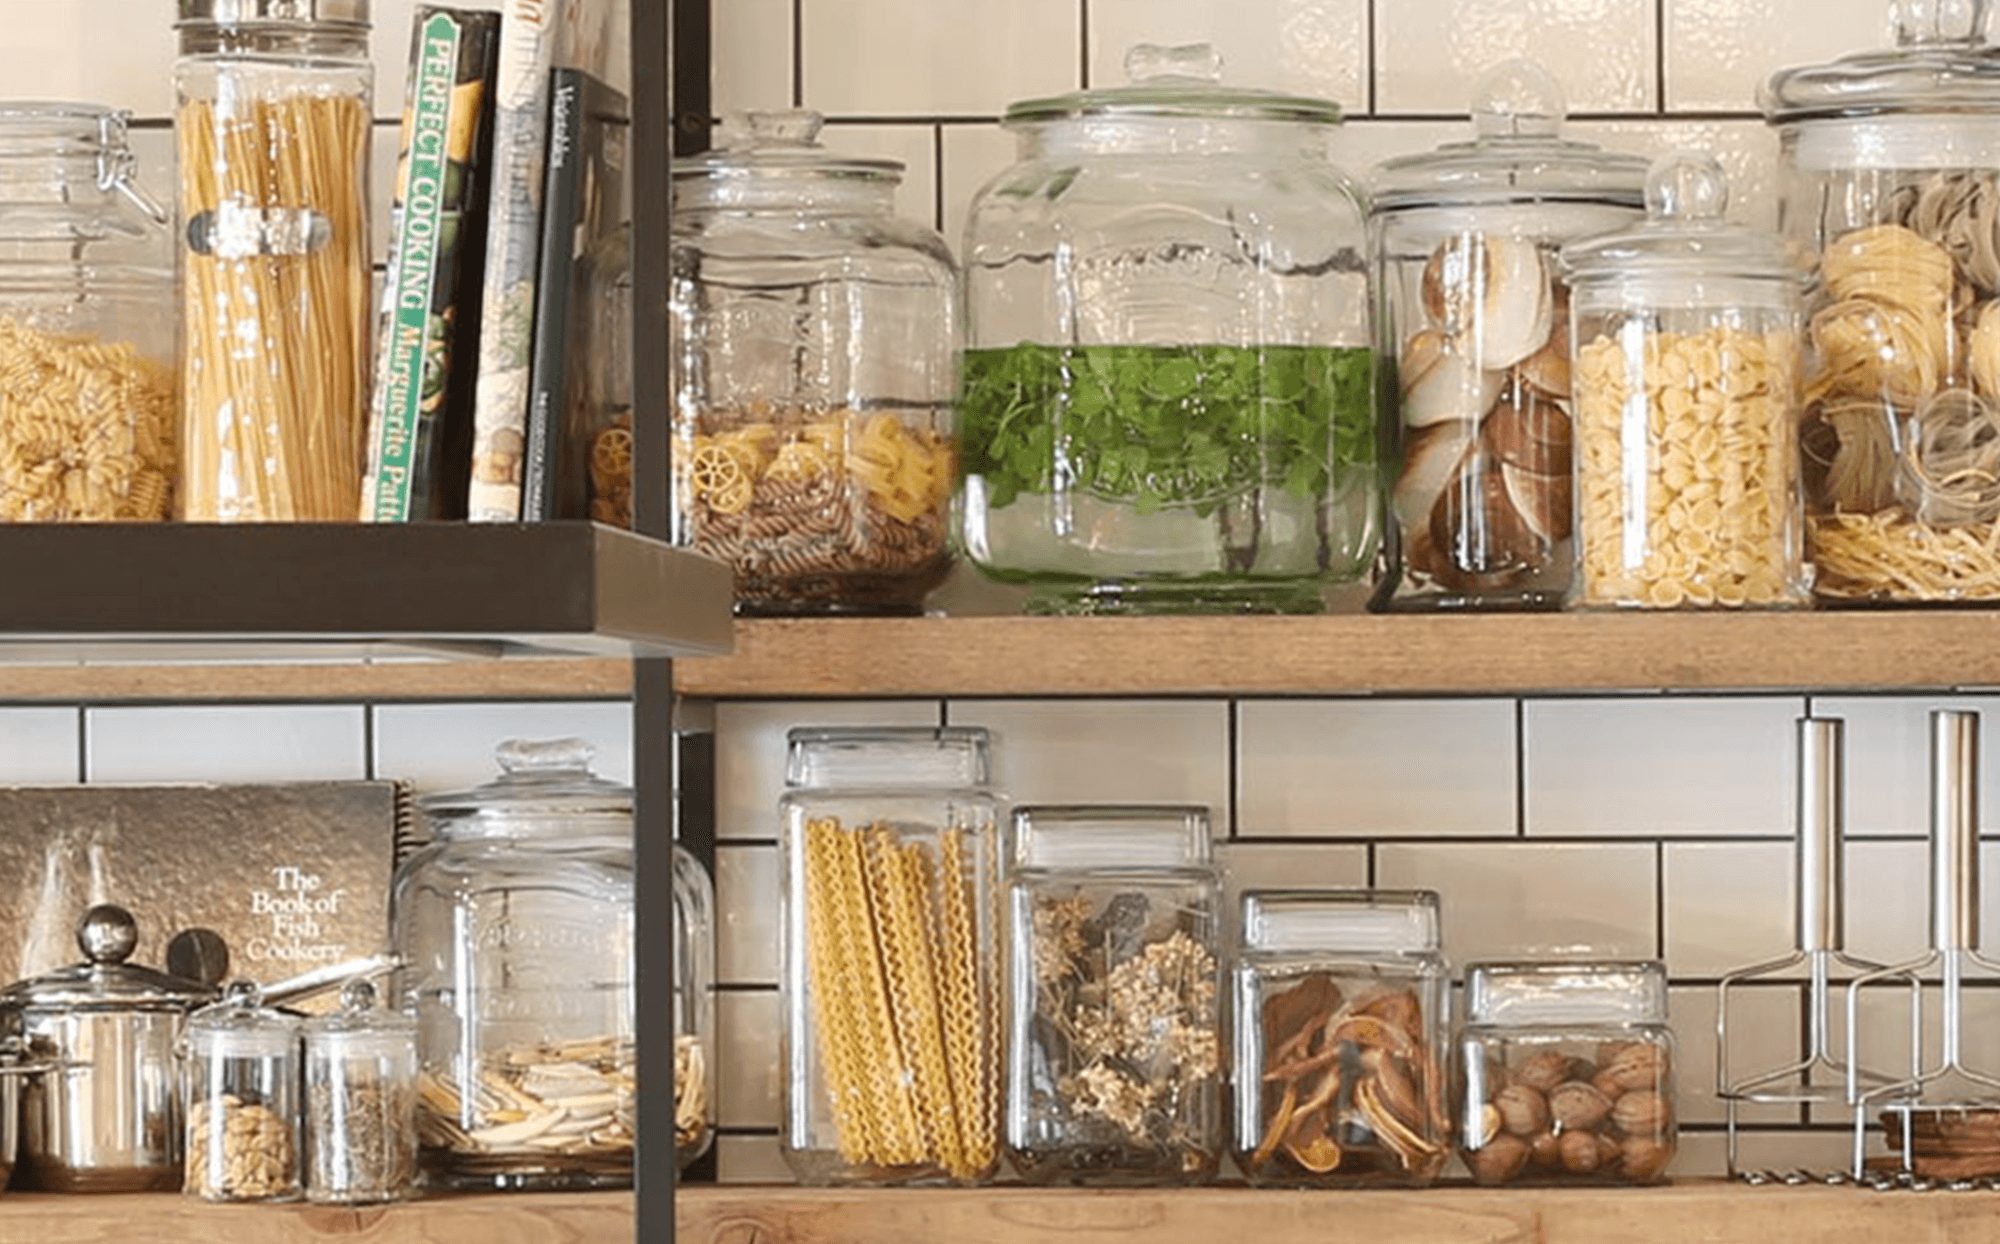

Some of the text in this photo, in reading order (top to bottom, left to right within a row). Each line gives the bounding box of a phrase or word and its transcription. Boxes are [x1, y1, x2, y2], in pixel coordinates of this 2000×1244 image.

[415, 37, 452, 168] PERFECT
[400, 176, 438, 310] COOKING
[384, 322, 421, 457] Marguerite
[272, 866, 321, 891] The
[250, 888, 347, 915] Book of
[272, 914, 321, 938] Fish
[246, 937, 346, 962] Cookery
